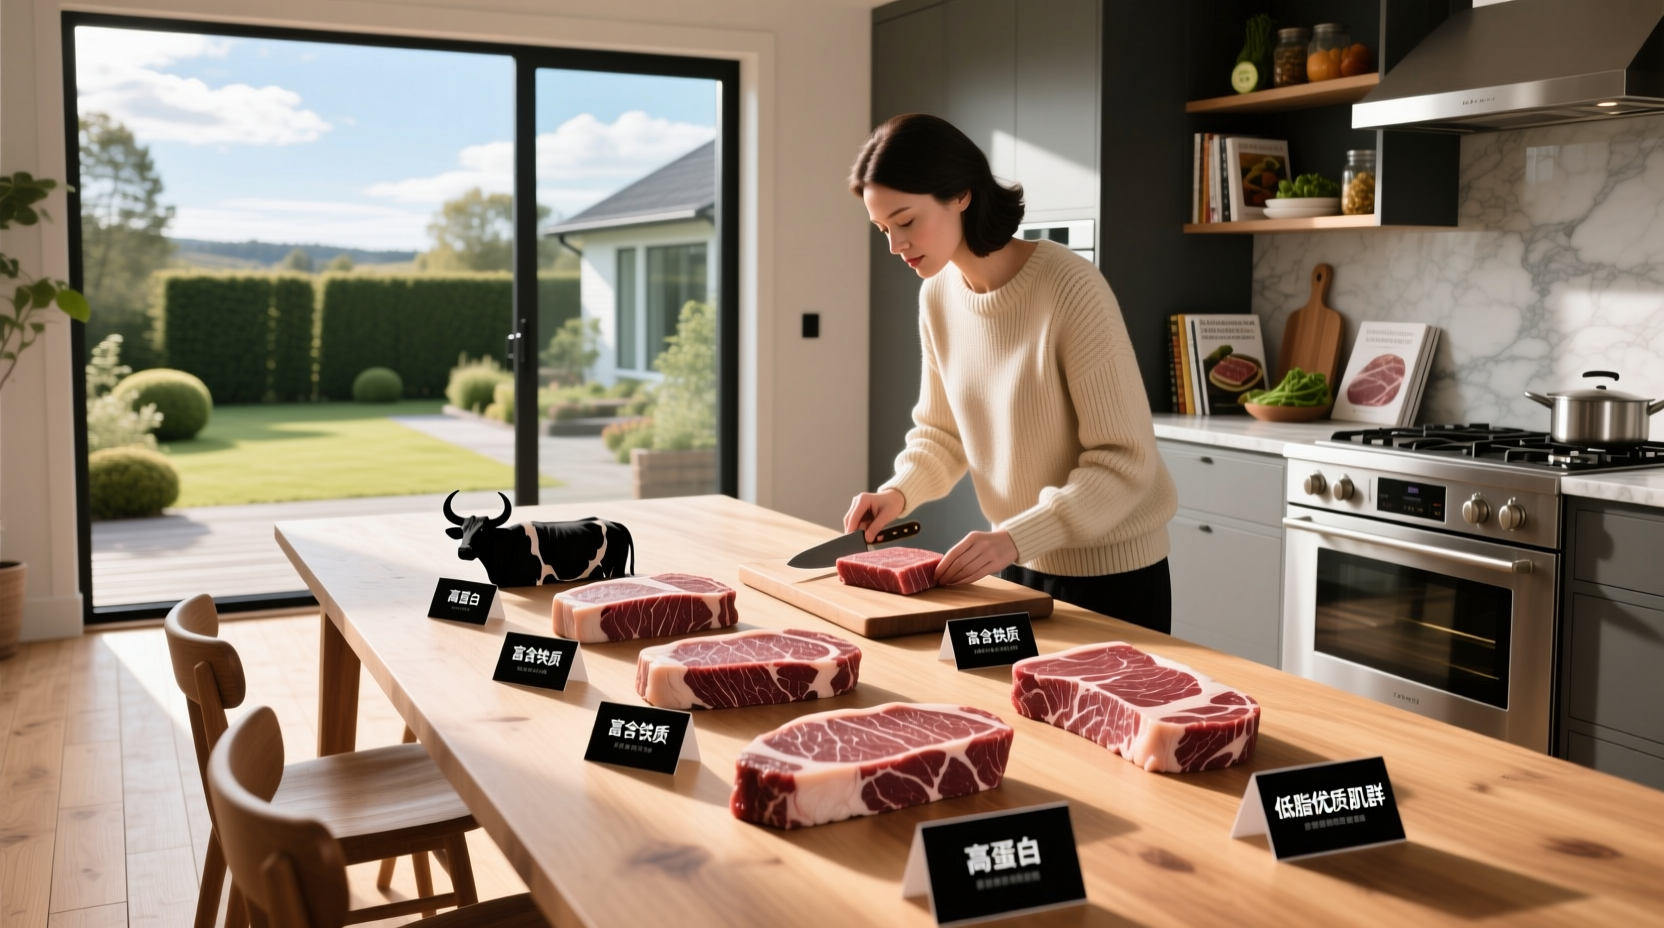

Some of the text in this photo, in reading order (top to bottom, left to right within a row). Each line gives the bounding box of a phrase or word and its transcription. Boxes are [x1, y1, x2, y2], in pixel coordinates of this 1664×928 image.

[1274, 782, 1386, 819] 低脂优质肌群
[964, 836, 1041, 875] 高蛋白
